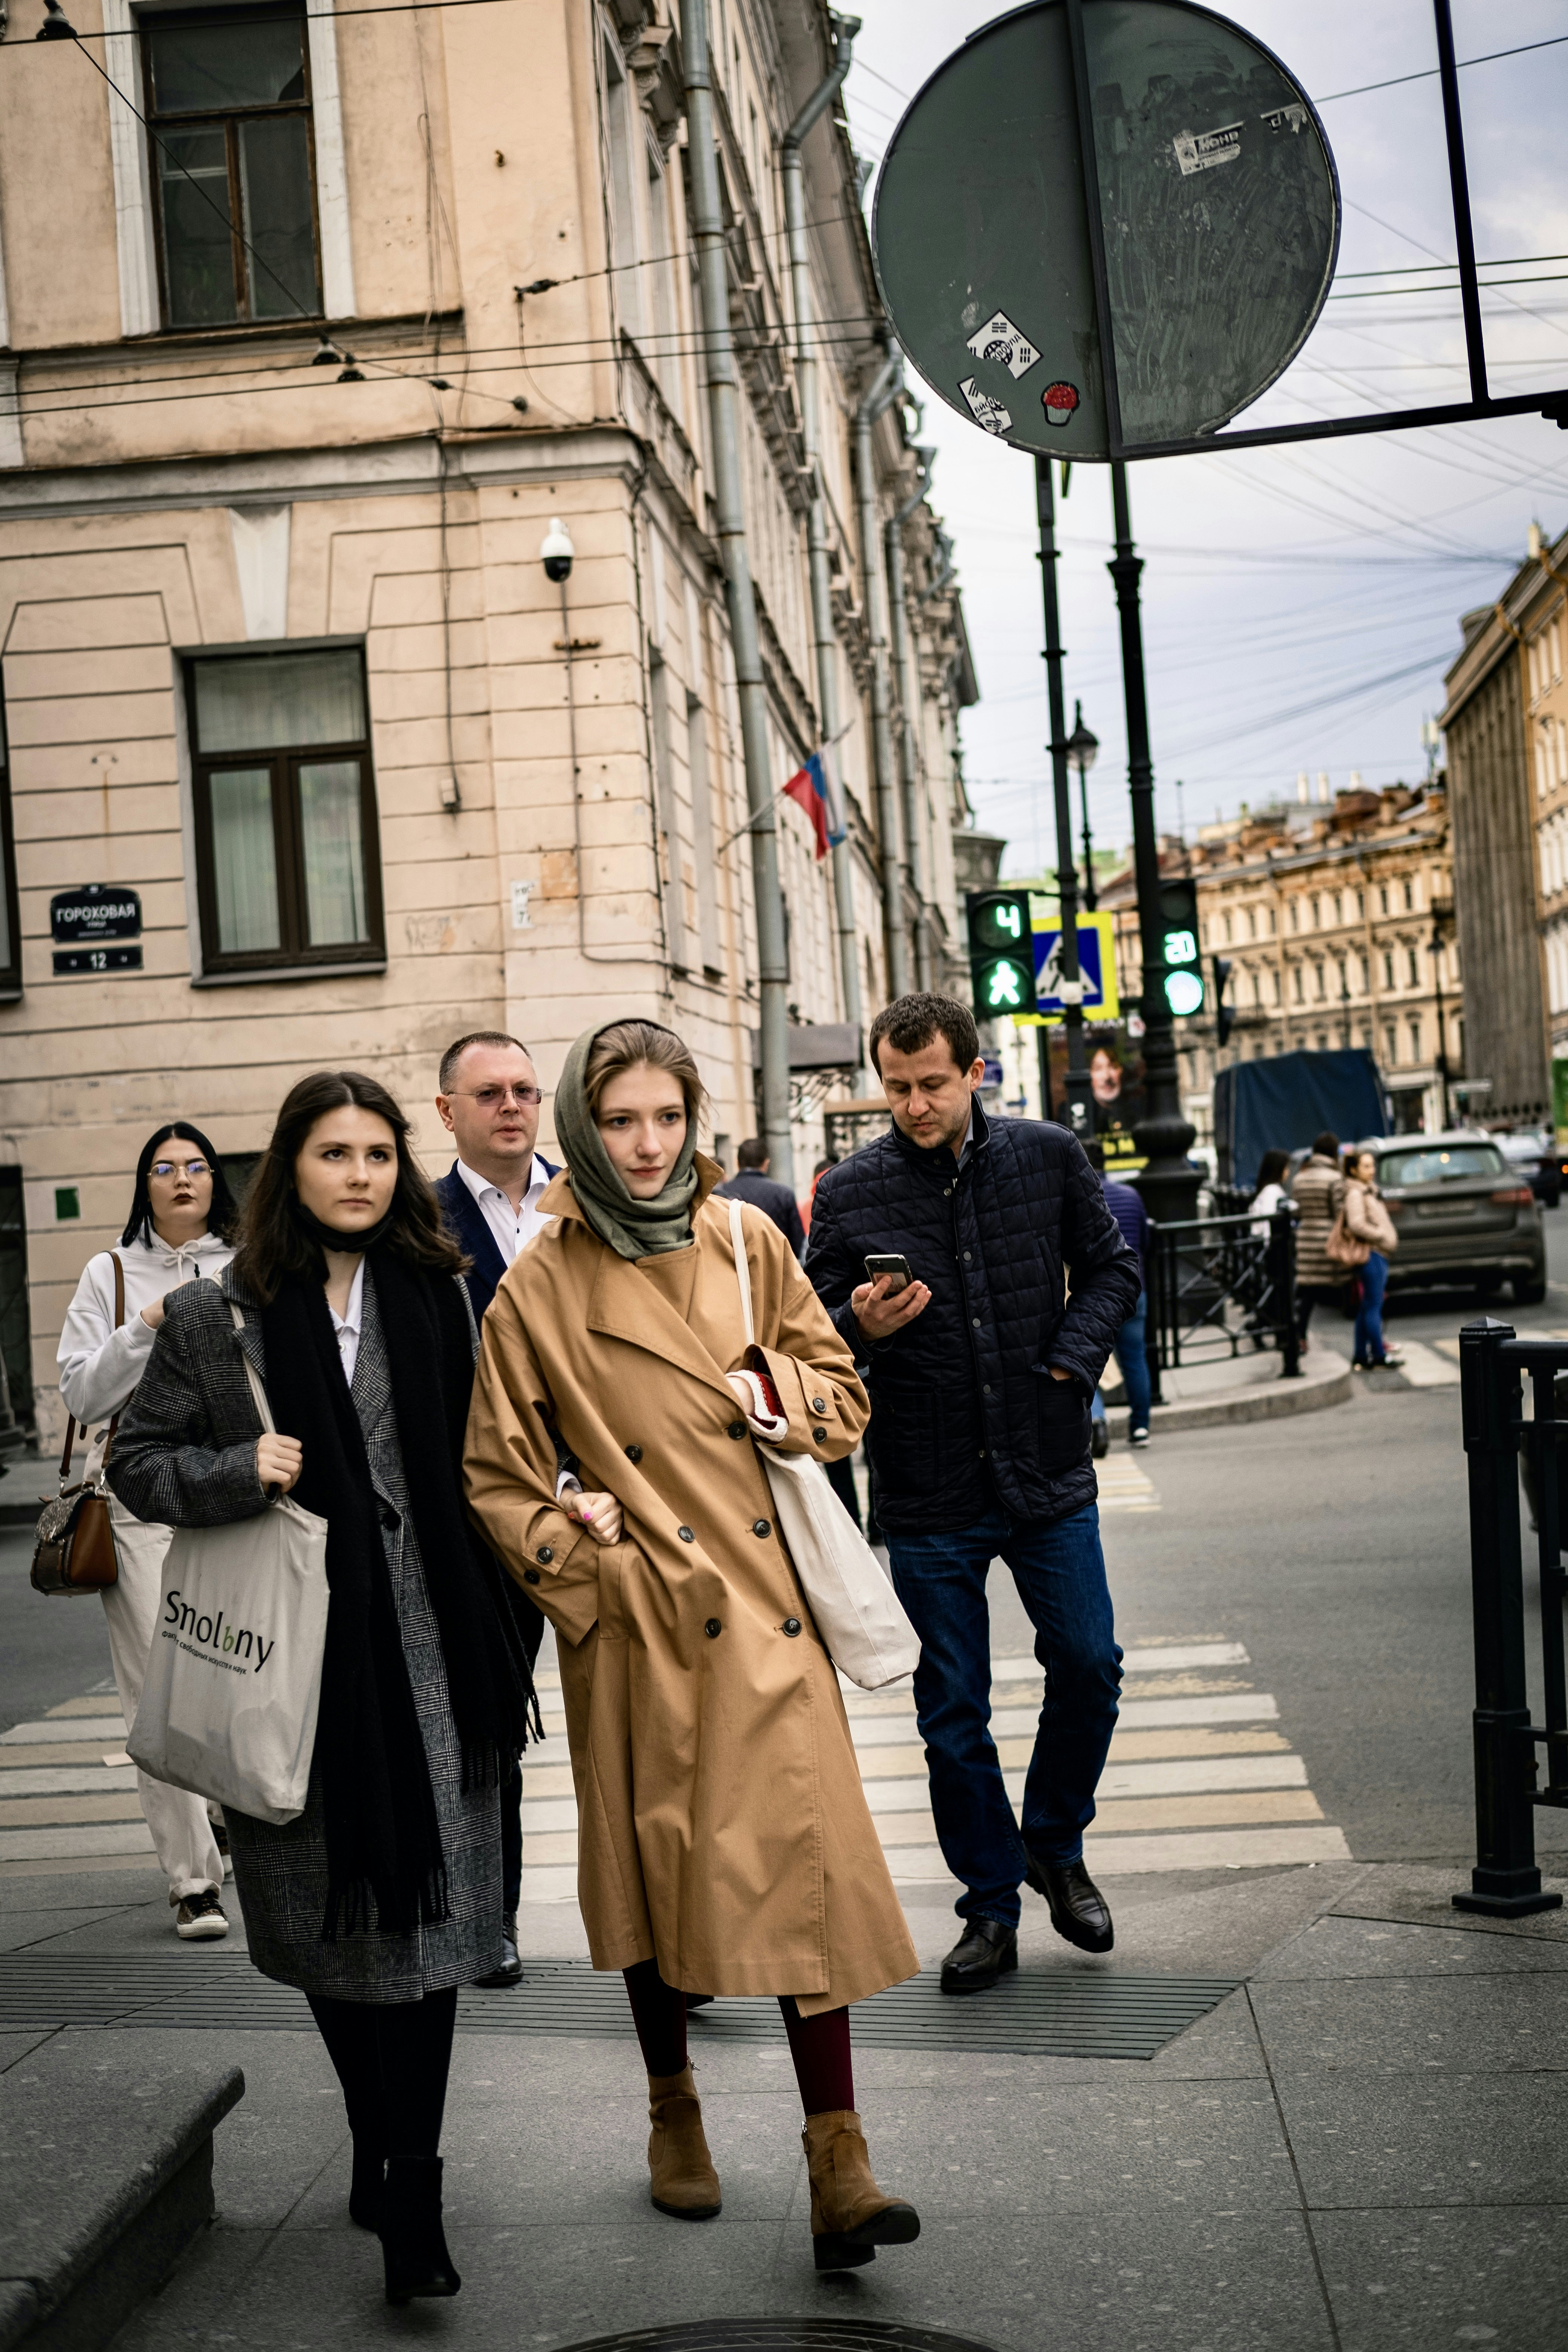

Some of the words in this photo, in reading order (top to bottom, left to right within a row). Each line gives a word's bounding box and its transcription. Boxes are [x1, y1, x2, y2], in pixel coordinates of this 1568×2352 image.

[56, 903, 135, 923] ГОРОХОВАЯ
[996, 905, 1020, 938] 4
[90, 952, 107, 969] 12
[233, 1665, 247, 1675] наук
